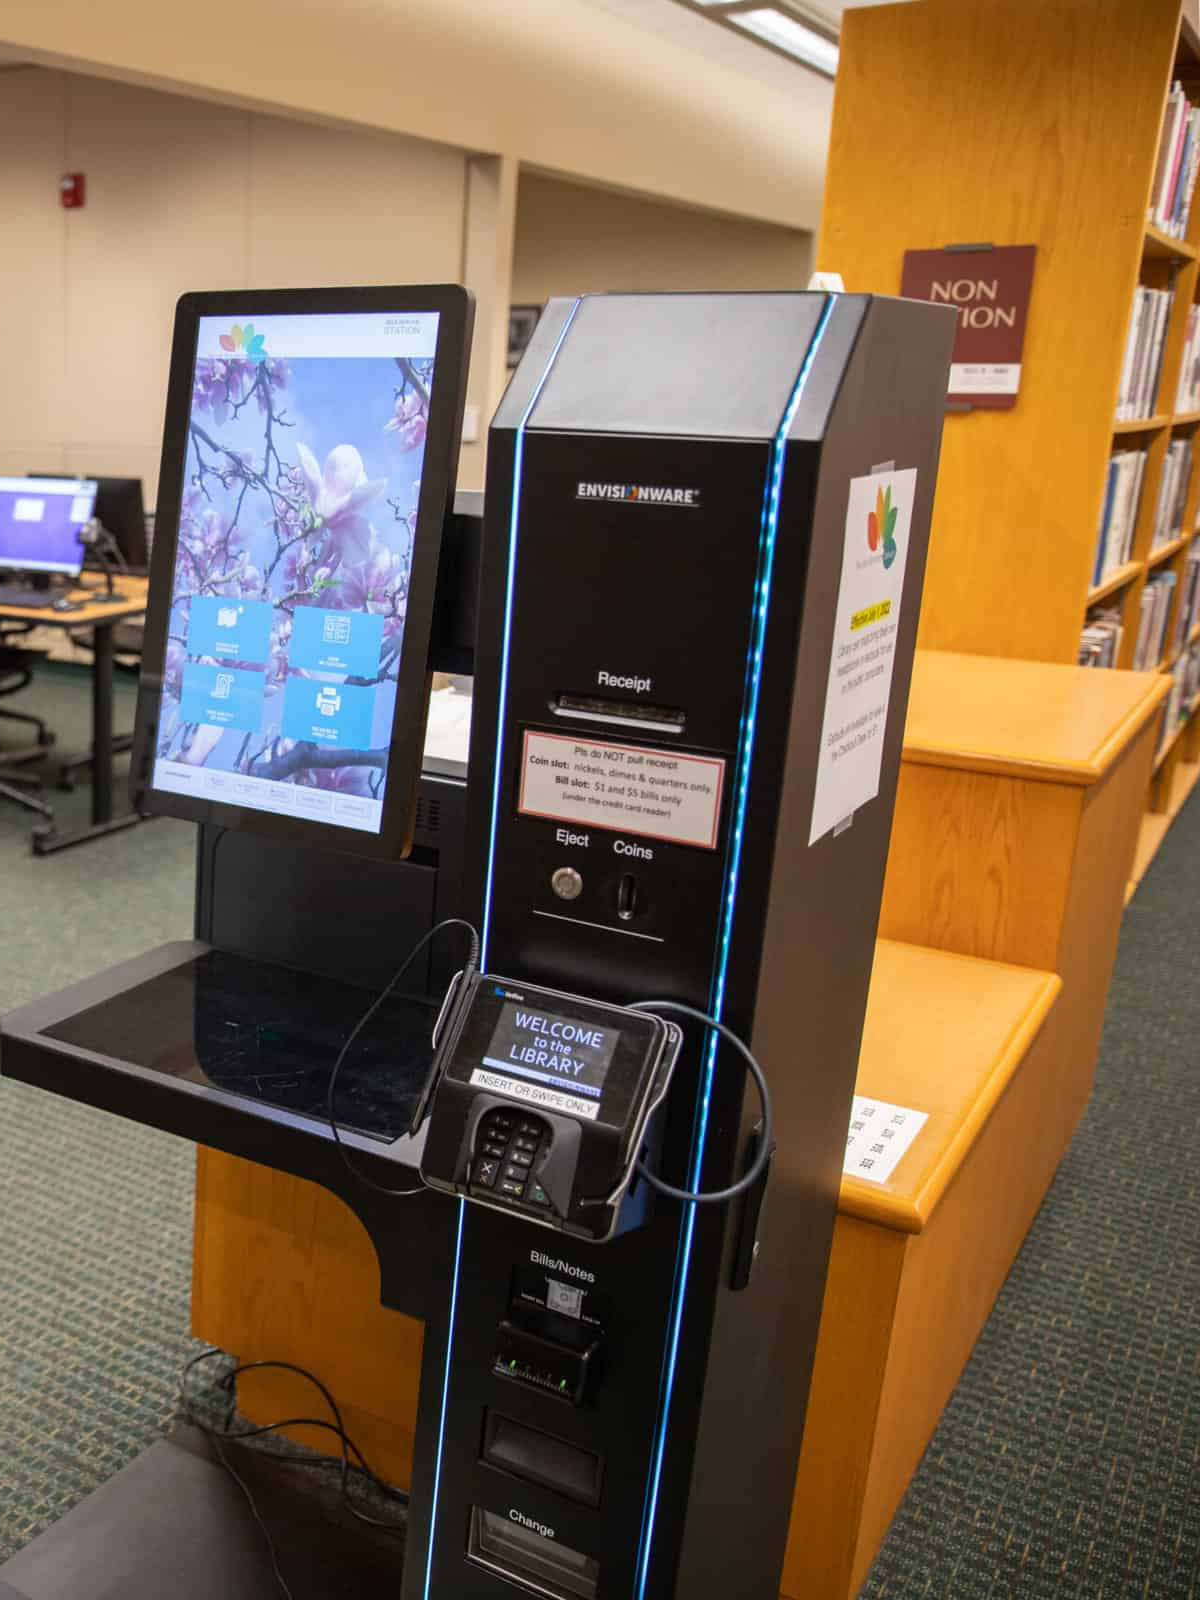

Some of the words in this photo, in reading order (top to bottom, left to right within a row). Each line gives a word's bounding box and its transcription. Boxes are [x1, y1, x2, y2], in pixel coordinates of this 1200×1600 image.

[930, 279, 998, 302] NON
[957, 305, 1017, 328] ION
[597, 671, 652, 694] Receipt
[574, 746, 588, 757] Pls
[590, 748, 602, 759] do
[603, 750, 625, 762] NOT
[627, 752, 644, 766] pull
[646, 755, 679, 771] receipt
[529, 755, 550, 767] Coin
[551, 757, 570, 770] slot:
[608, 767, 637, 782] dimes
[638, 771, 646, 783] &
[648, 774, 688, 791] quarters
[555, 775, 570, 786] Bill
[571, 777, 590, 790] slot:
[608, 782, 625, 796] and
[640, 788, 660, 801] bills
[661, 792, 683, 807] only
[588, 793, 601, 805] the
[601, 796, 624, 809] credit
[625, 800, 642, 812] card
[556, 829, 589, 847] Eject
[613, 839, 655, 860] Coins
[515, 1011, 604, 1049] WELCOME
[533, 1036, 548, 1049] to
[549, 1039, 572, 1056] the
[509, 1044, 585, 1077] LIBRARY
[478, 1073, 514, 1091] INSERT
[514, 1083, 531, 1097] OR
[531, 1087, 564, 1107] SWIPE
[565, 1096, 595, 1114] ONLY
[530, 1250, 596, 1283] Bills/Notes
[509, 1508, 555, 1537] Change
